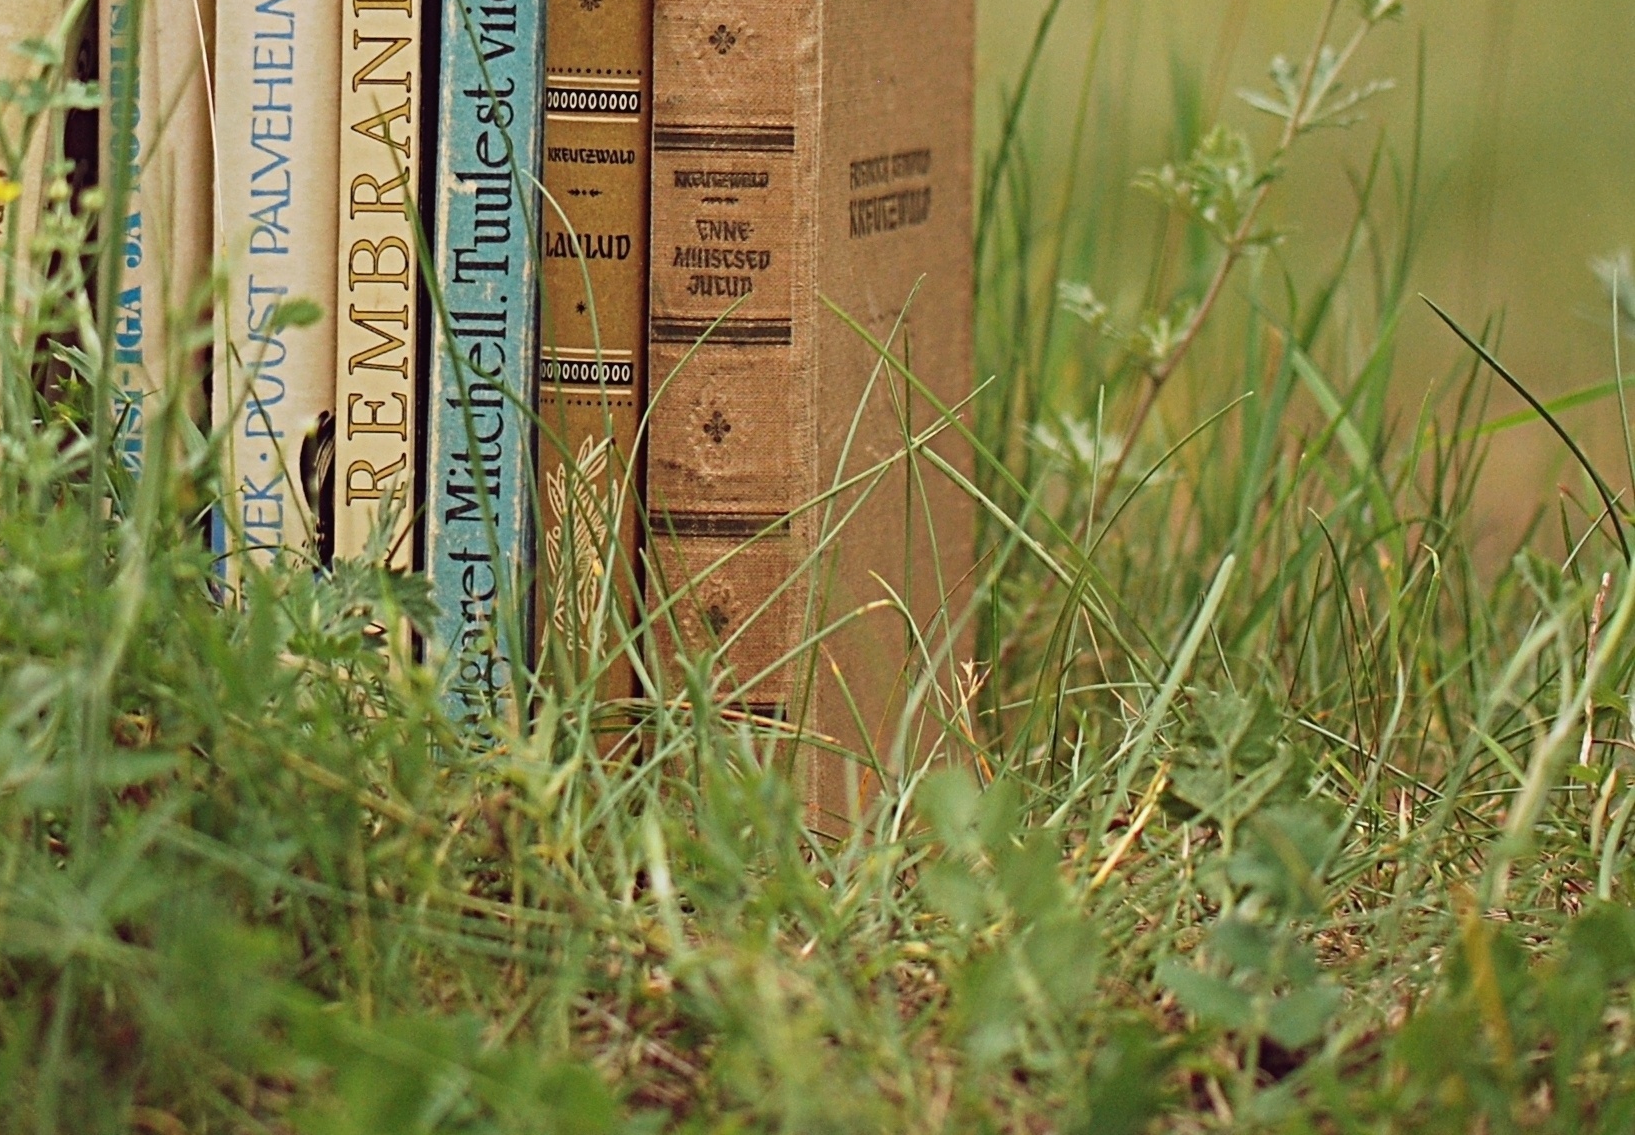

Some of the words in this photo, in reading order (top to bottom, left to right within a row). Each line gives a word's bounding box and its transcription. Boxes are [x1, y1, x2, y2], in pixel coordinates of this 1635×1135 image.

[452, 77, 516, 284] Tuulest
[547, 146, 636, 165] KREUTZWALD
[116, 211, 143, 268] JA
[545, 231, 632, 260] LAULUD
[695, 218, 755, 242] ENNE-
[686, 275, 753, 298] JUTUD
[246, 274, 289, 438] PUUST
[243, 473, 285, 561] ZEK
[448, 547, 511, 753] argaret
